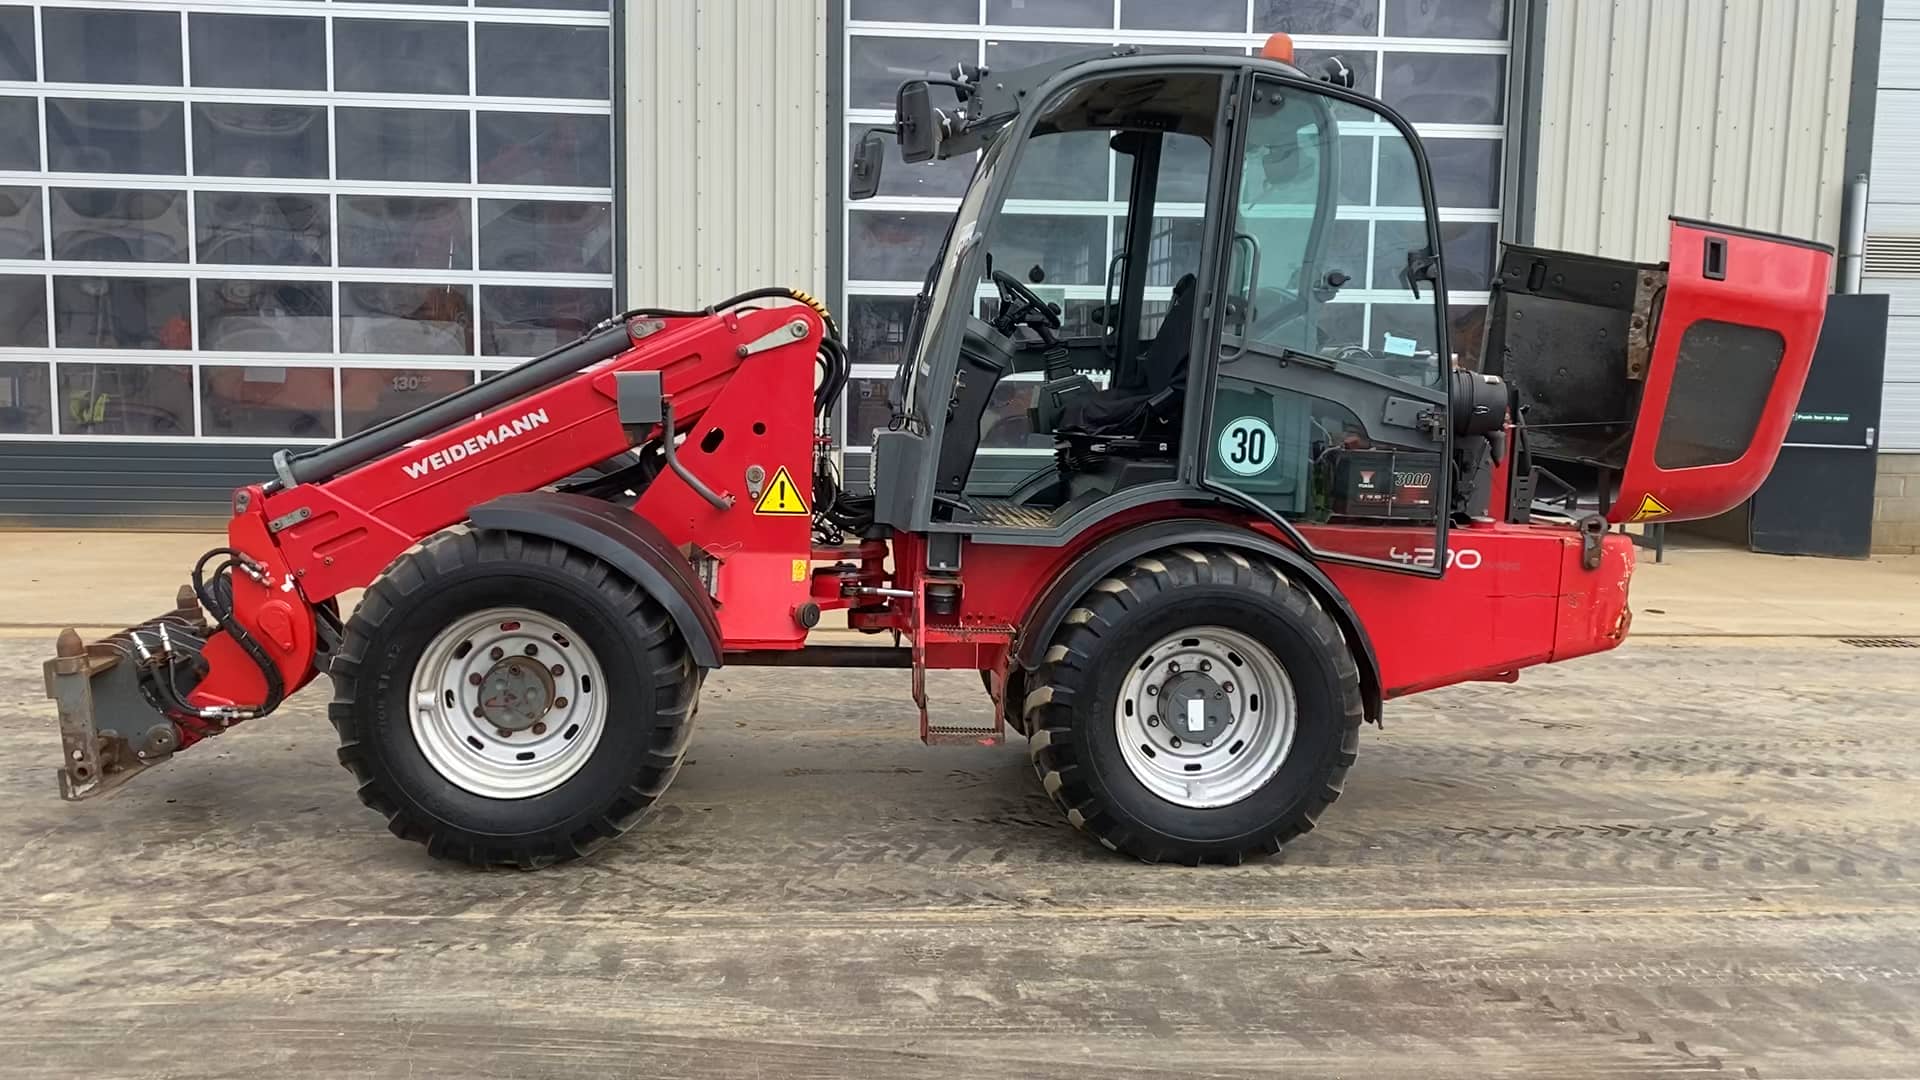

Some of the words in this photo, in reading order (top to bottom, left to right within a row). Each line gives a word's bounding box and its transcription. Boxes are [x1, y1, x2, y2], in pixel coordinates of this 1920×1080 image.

[402, 408, 550, 480] WEIDEMANN
[1230, 427, 1266, 465] 30
[1395, 472, 1432, 487] 3000
